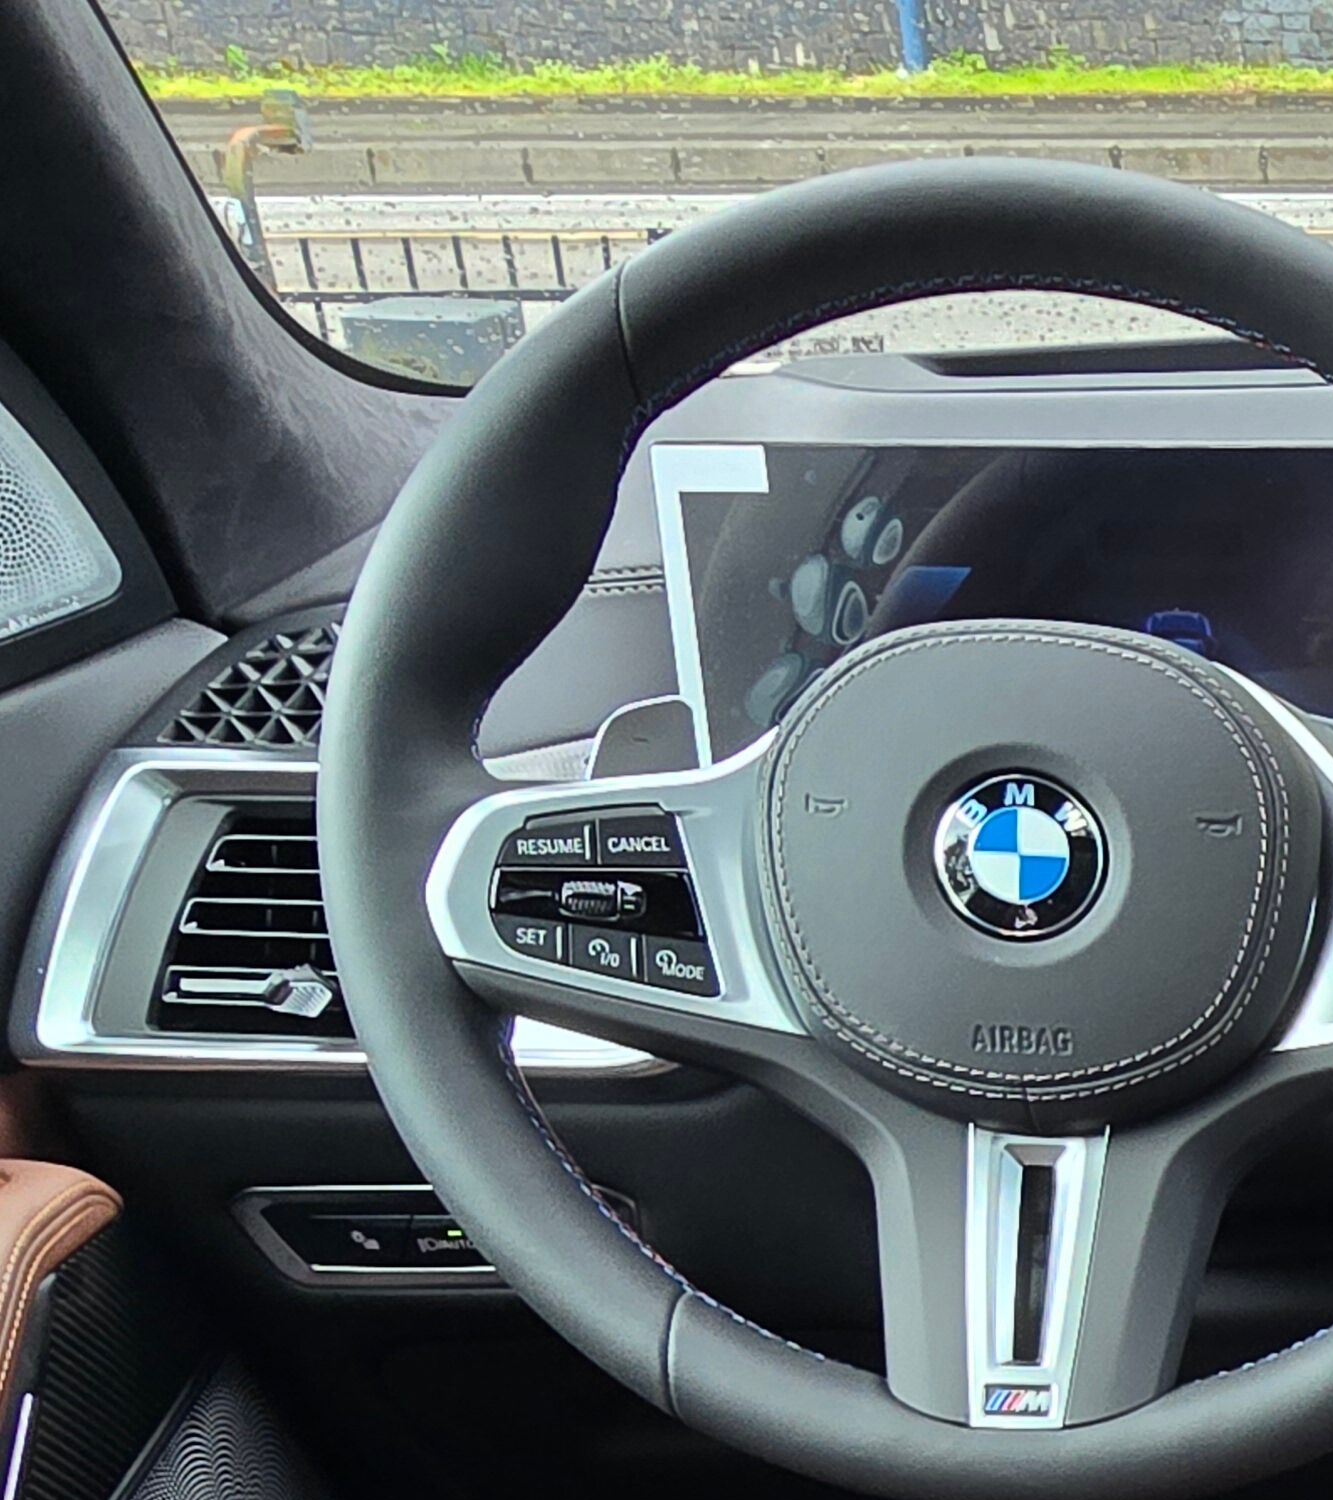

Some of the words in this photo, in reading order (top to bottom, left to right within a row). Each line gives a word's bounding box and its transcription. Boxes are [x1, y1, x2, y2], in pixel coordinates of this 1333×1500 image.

[956, 782, 1088, 832] BMW
[517, 837, 583, 856] RESUME
[608, 836, 670, 853] CANCEL
[516, 928, 547, 945] SET
[662, 962, 705, 981] MODE
[972, 1024, 1073, 1056] AIRBAG
